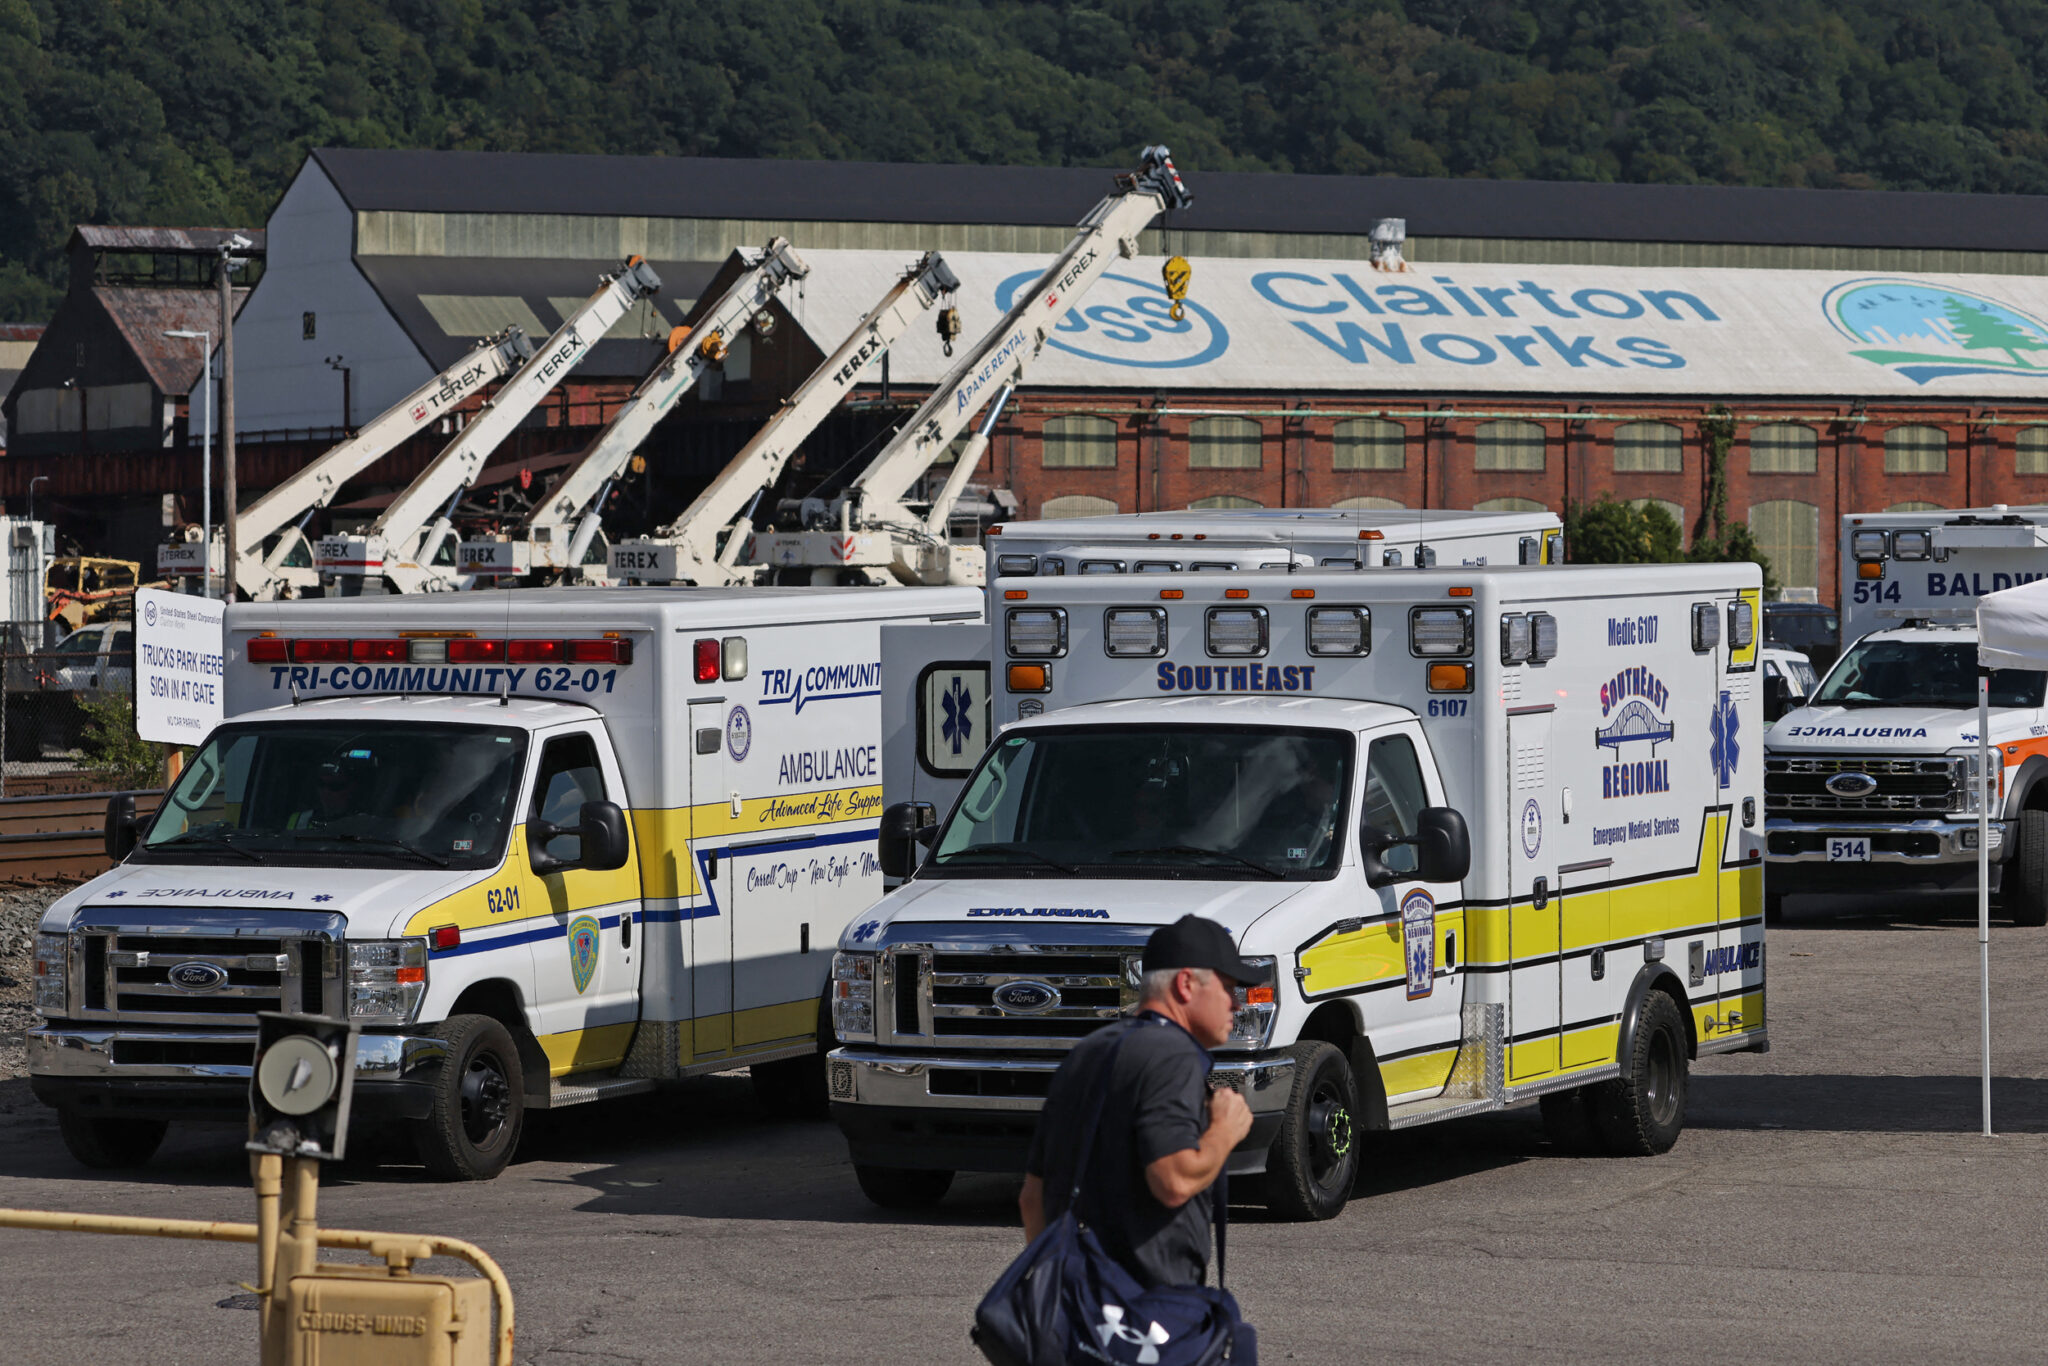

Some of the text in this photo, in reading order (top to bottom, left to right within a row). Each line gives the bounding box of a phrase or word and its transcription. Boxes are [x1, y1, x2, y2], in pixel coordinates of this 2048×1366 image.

[1056, 248, 1097, 293] TEREX
[1251, 271, 1721, 322] Clairton
[534, 335, 582, 385] TEREX
[833, 335, 880, 386] TEREX
[1289, 320, 1687, 369] Works
[428, 363, 486, 407] TEREX
[164, 549, 196, 561] TEREX
[615, 552, 659, 569] TEREX
[1853, 581, 1902, 604] 514
[1608, 615, 1658, 647] Medic 6107
[142, 643, 224, 676] TRUCKS PARK HERE
[150, 675, 215, 705] SIGN IN AT GATE
[269, 667, 617, 693] TRI-COMMUNITY 62-01
[761, 668, 792, 696] TRI
[1600, 664, 1669, 718] SOUTHEAST
[1427, 699, 1467, 718] 6107
[778, 746, 877, 786] AMBULANCE
[1603, 759, 1670, 800] REGIONAL
[759, 791, 882, 823] Advanced Life Suppo
[1593, 816, 1680, 846] Emergency Medical Services
[1832, 841, 1866, 858] 514
[747, 864, 778, 893] Carroll
[827, 856, 849, 888] Eagle
[487, 885, 520, 914] 62-01
[1703, 940, 1760, 977] AMBULANCE
[181, 968, 207, 983] Ford
[1008, 988, 1036, 1004] Ford
